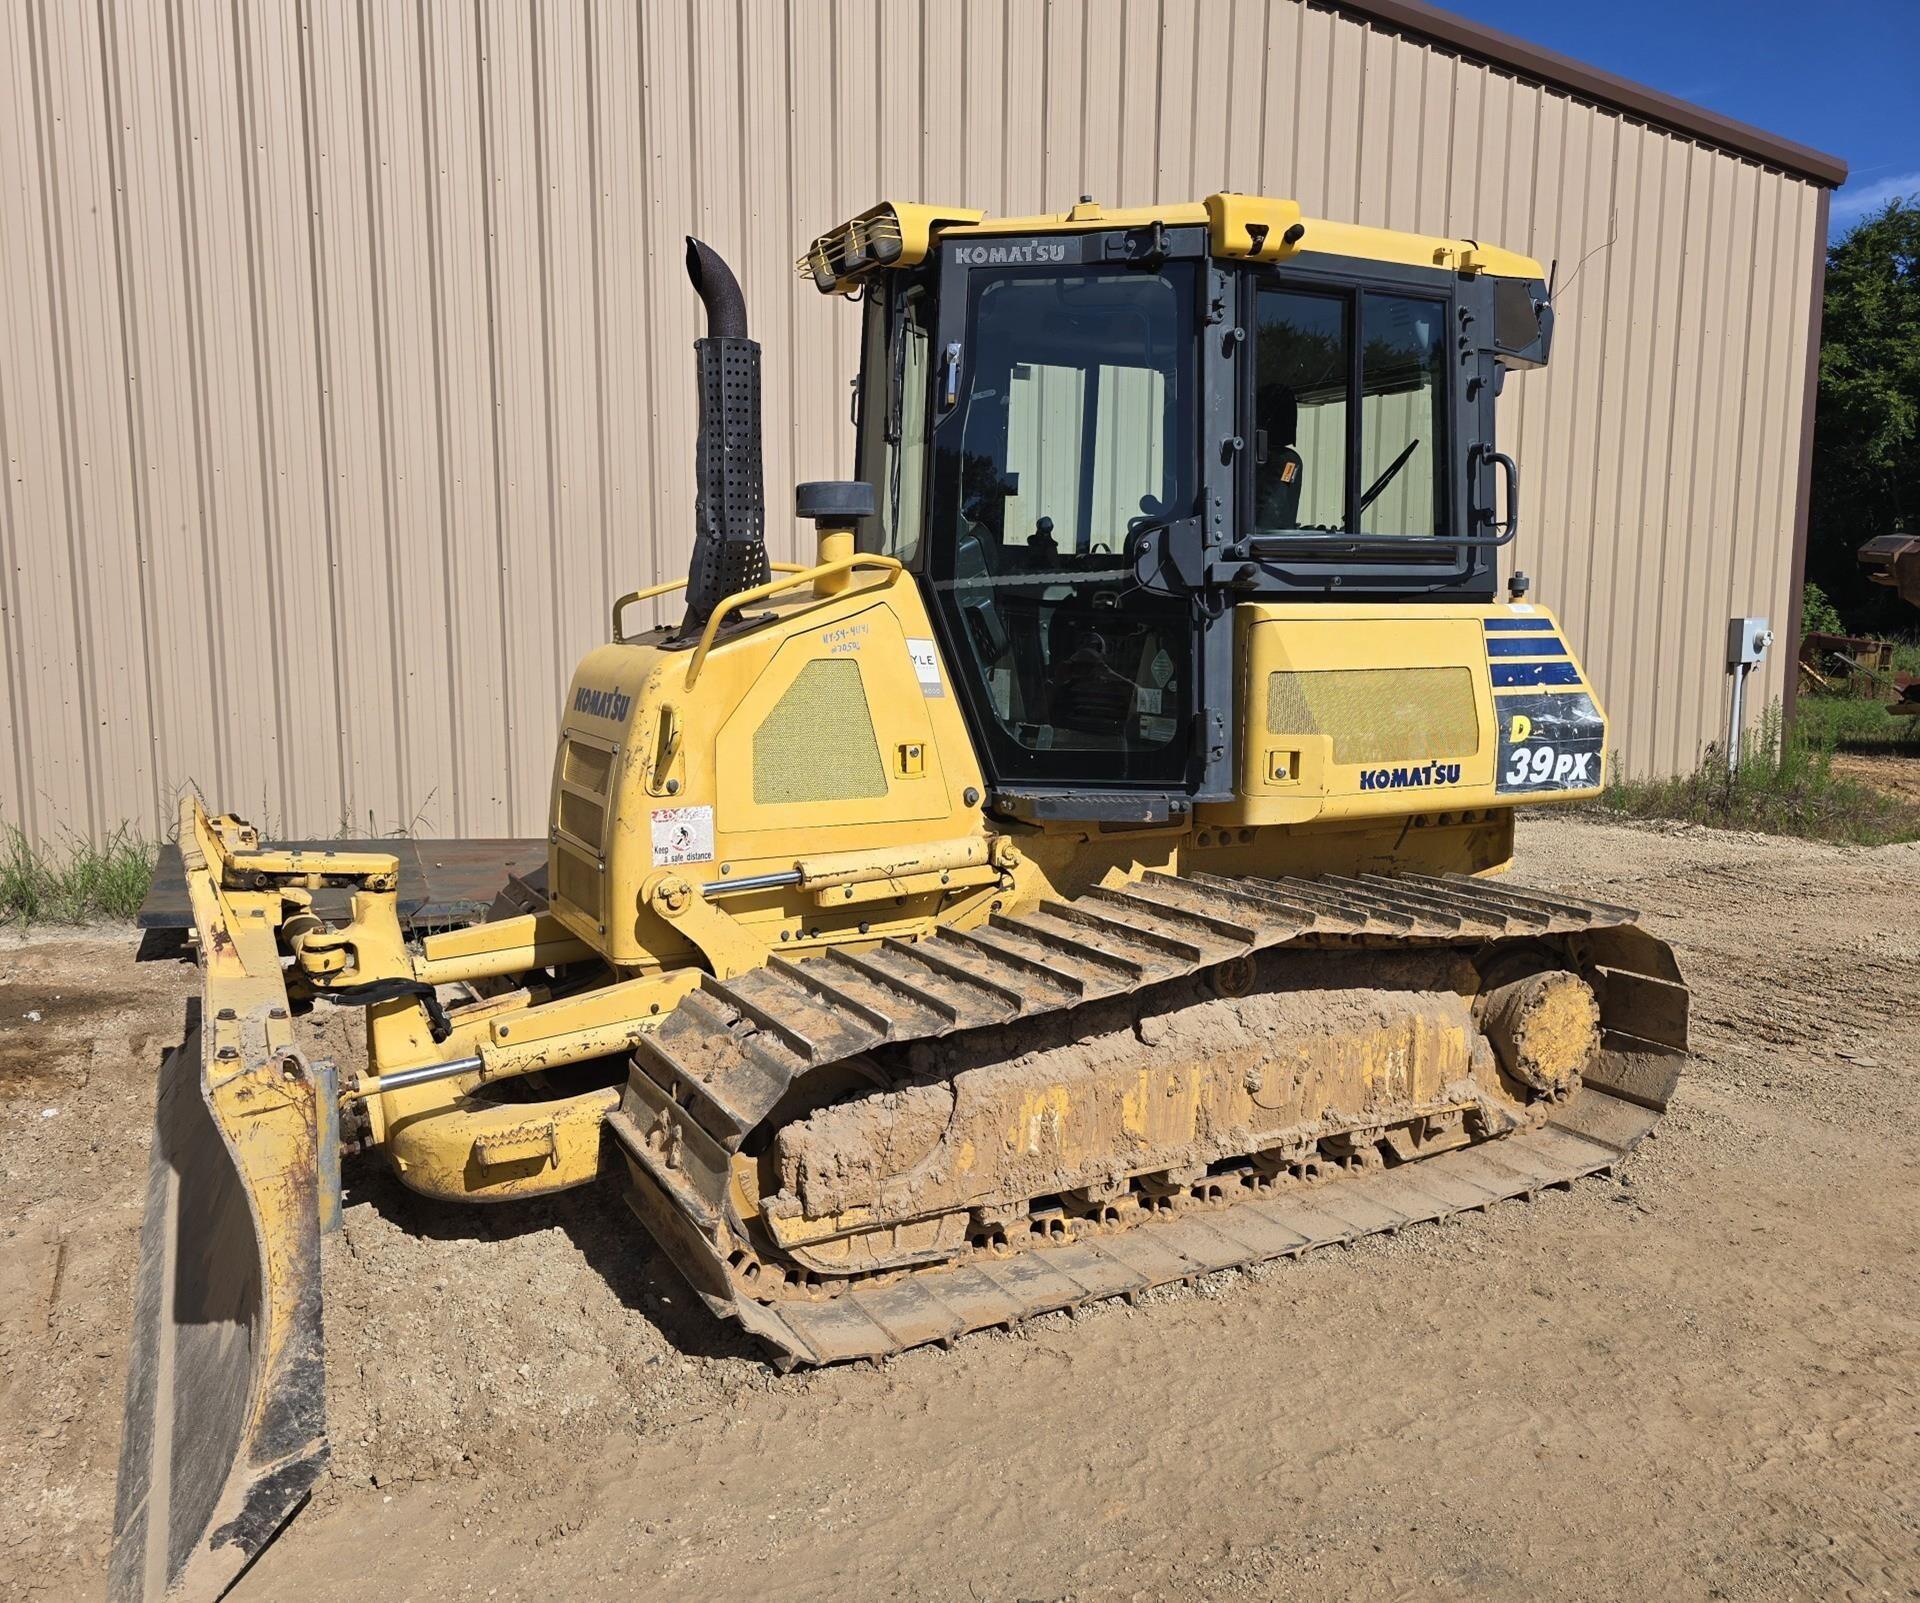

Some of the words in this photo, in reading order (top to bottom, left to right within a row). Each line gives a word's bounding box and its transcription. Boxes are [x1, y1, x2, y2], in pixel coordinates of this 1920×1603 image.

[955, 240, 1065, 264] KOMATSU
[573, 686, 631, 722] KOMATSU
[1509, 714, 1532, 743] D
[1360, 760, 1461, 790] KOMATSU
[1506, 746, 1592, 786] 39PX
[654, 845, 669, 855] Keep
[671, 853, 684, 862] safe
[686, 851, 712, 861] distance
